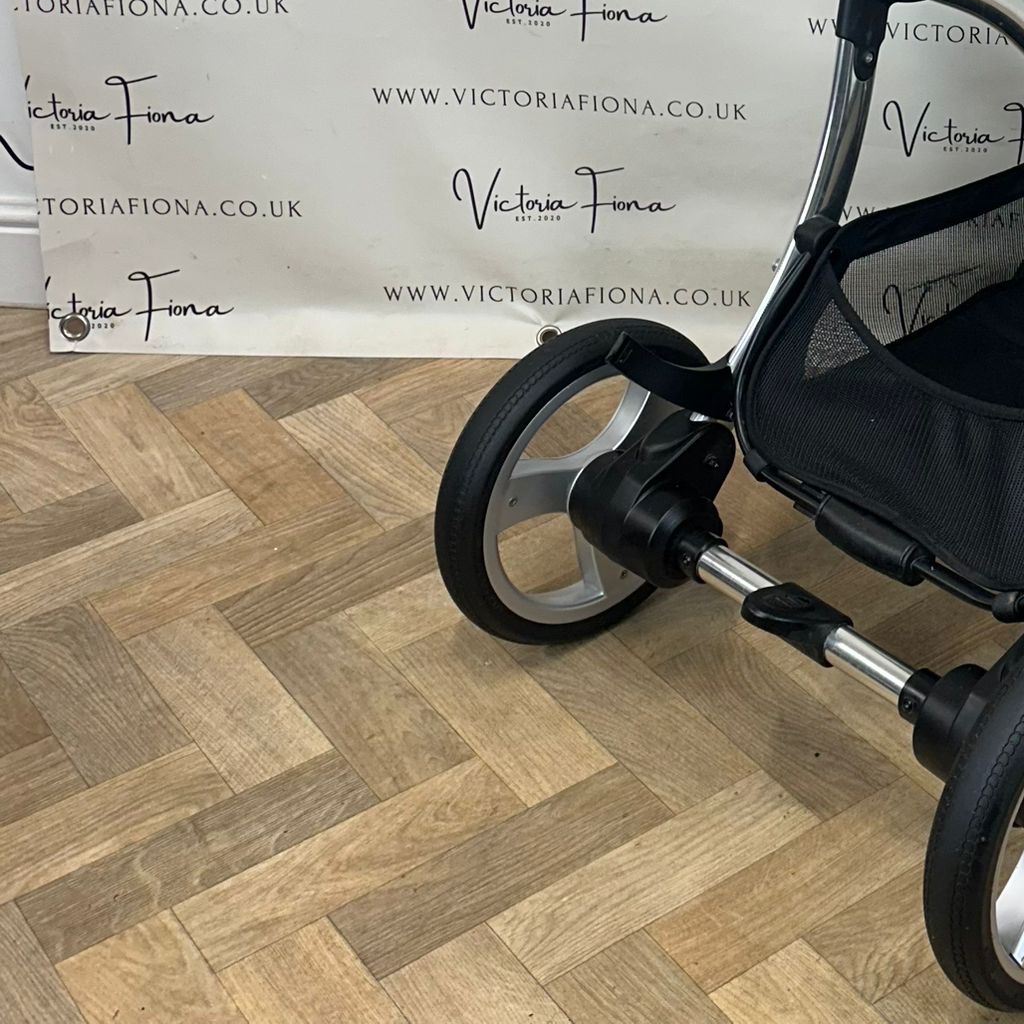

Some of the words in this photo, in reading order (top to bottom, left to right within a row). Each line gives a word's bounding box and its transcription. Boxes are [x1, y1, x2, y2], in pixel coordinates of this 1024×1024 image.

[104, 74, 215, 146] Fiona
[371, 87, 747, 121] WWW.VICTORIAFIONA.CO.UK
[882, 99, 1006, 158] Victoria
[35, 197, 303, 218] TORIAFIONA.CO.UK
[452, 167, 579, 231] Victoria
[574, 165, 677, 235] Fiona
[127, 268, 235, 343] Fiona
[382, 284, 752, 308] WWW.VICTORIAFIONA.CO.UK
